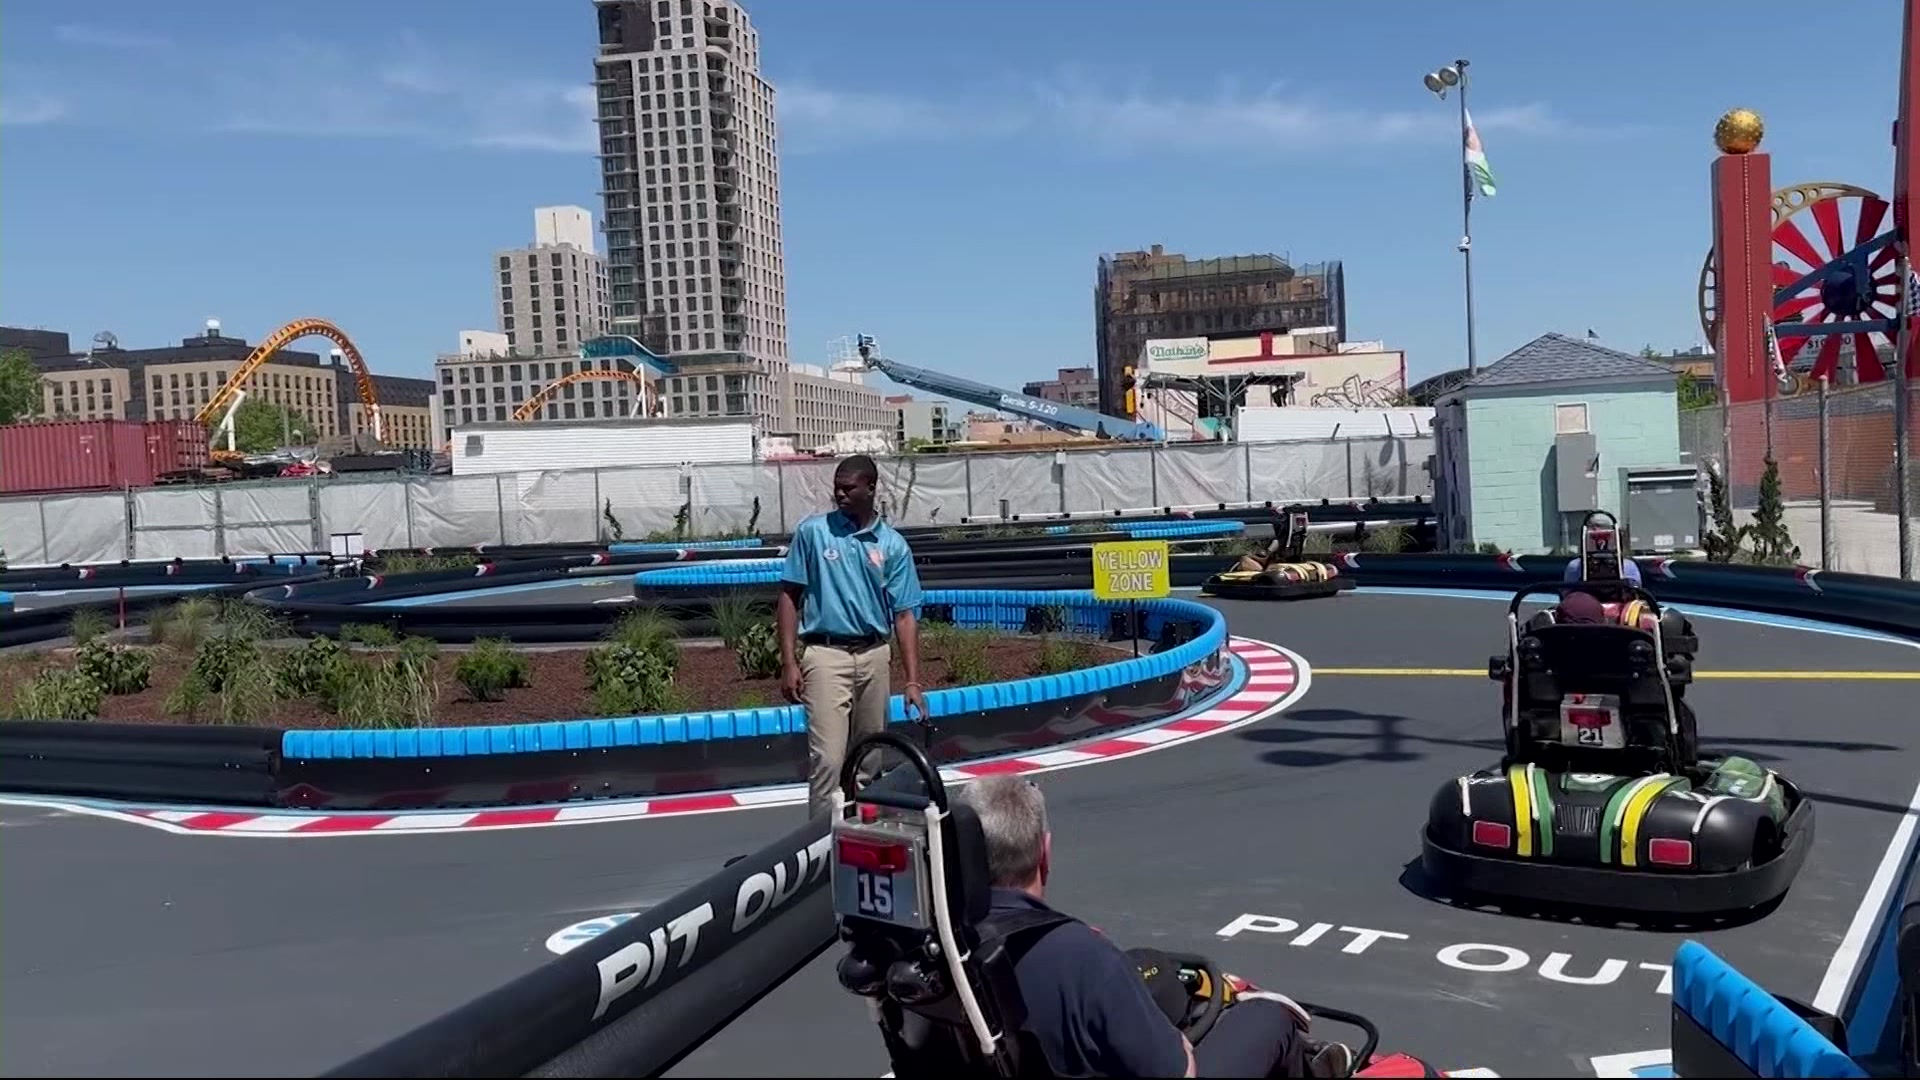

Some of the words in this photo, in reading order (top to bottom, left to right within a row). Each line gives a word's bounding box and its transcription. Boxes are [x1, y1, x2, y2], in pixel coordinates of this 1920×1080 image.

[1097, 549, 1163, 571] YELLOW
[1109, 572, 1154, 592] ZONE
[1579, 727, 1602, 743] 21
[858, 872, 893, 914] 15
[591, 901, 714, 1022] PIT
[731, 832, 832, 934] OUT
[1215, 913, 1410, 955] PIT
